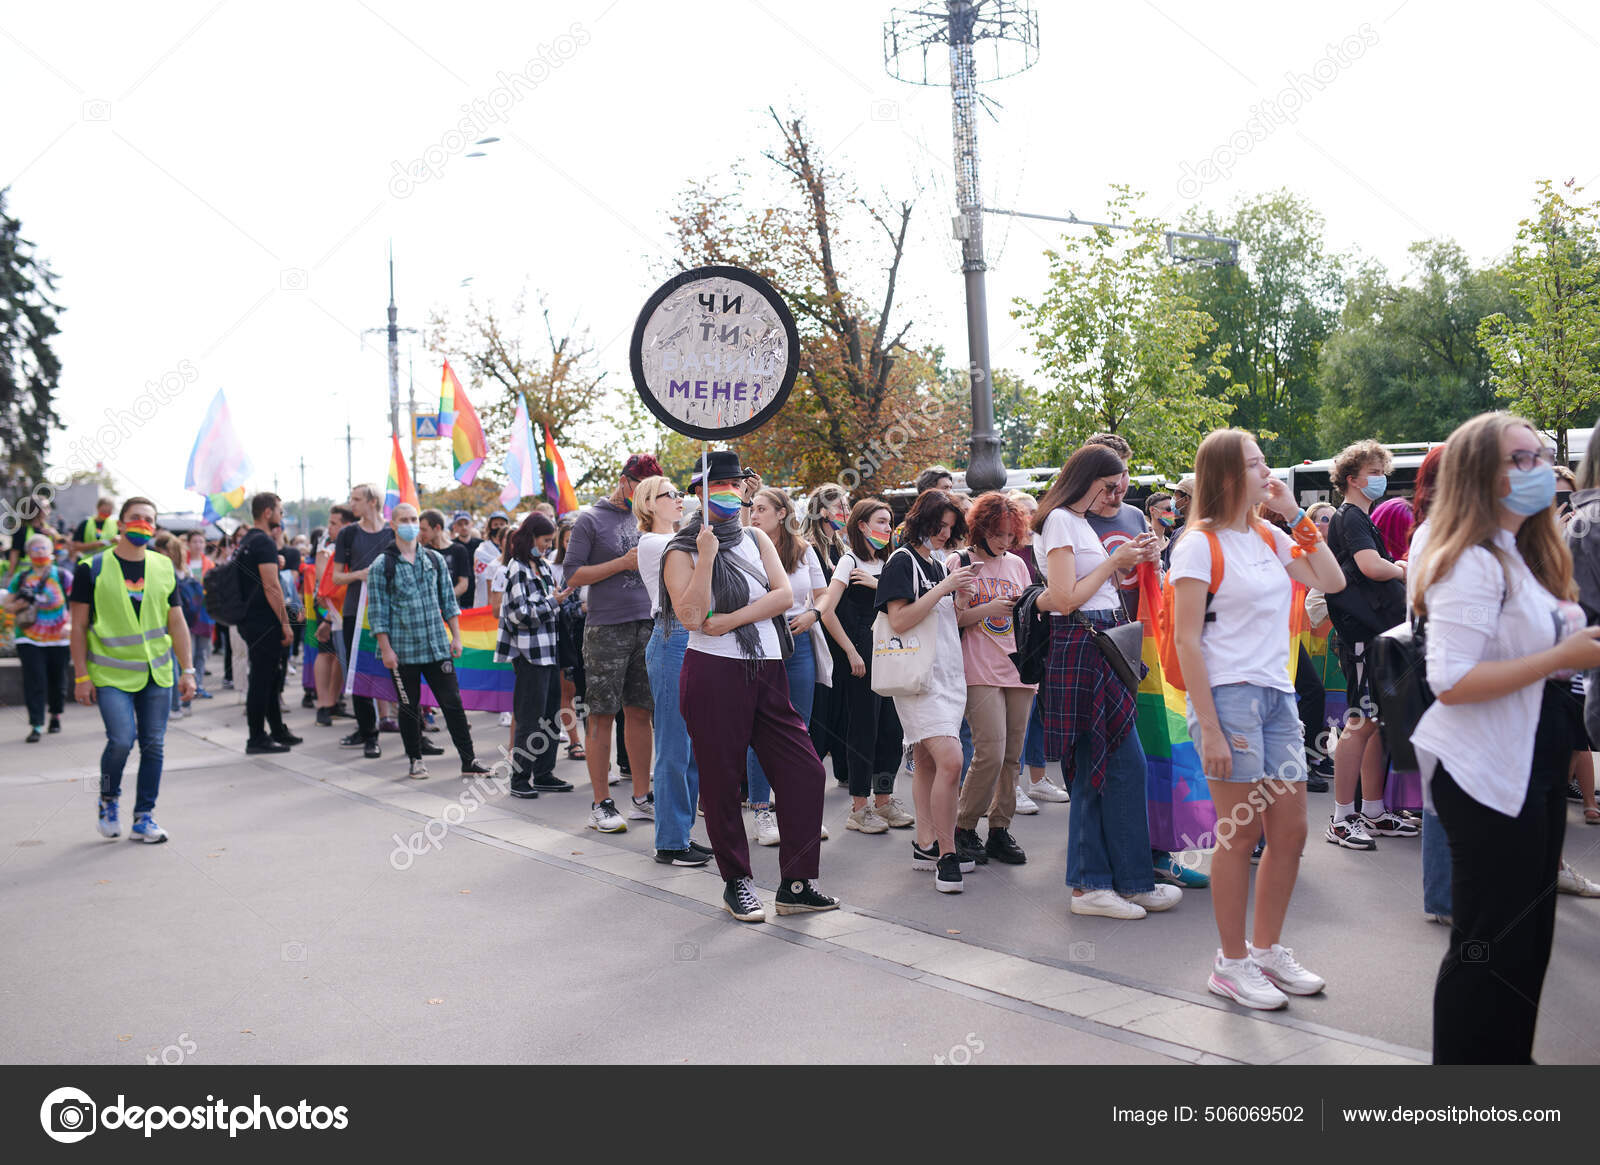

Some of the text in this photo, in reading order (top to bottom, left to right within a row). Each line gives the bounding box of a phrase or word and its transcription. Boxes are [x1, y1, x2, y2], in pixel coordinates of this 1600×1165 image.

[698, 293, 742, 314] ЧИ
[699, 322, 740, 345] ТИ
[662, 351, 775, 376] БАЧИШ
[669, 380, 762, 401] МЕНЕ?
